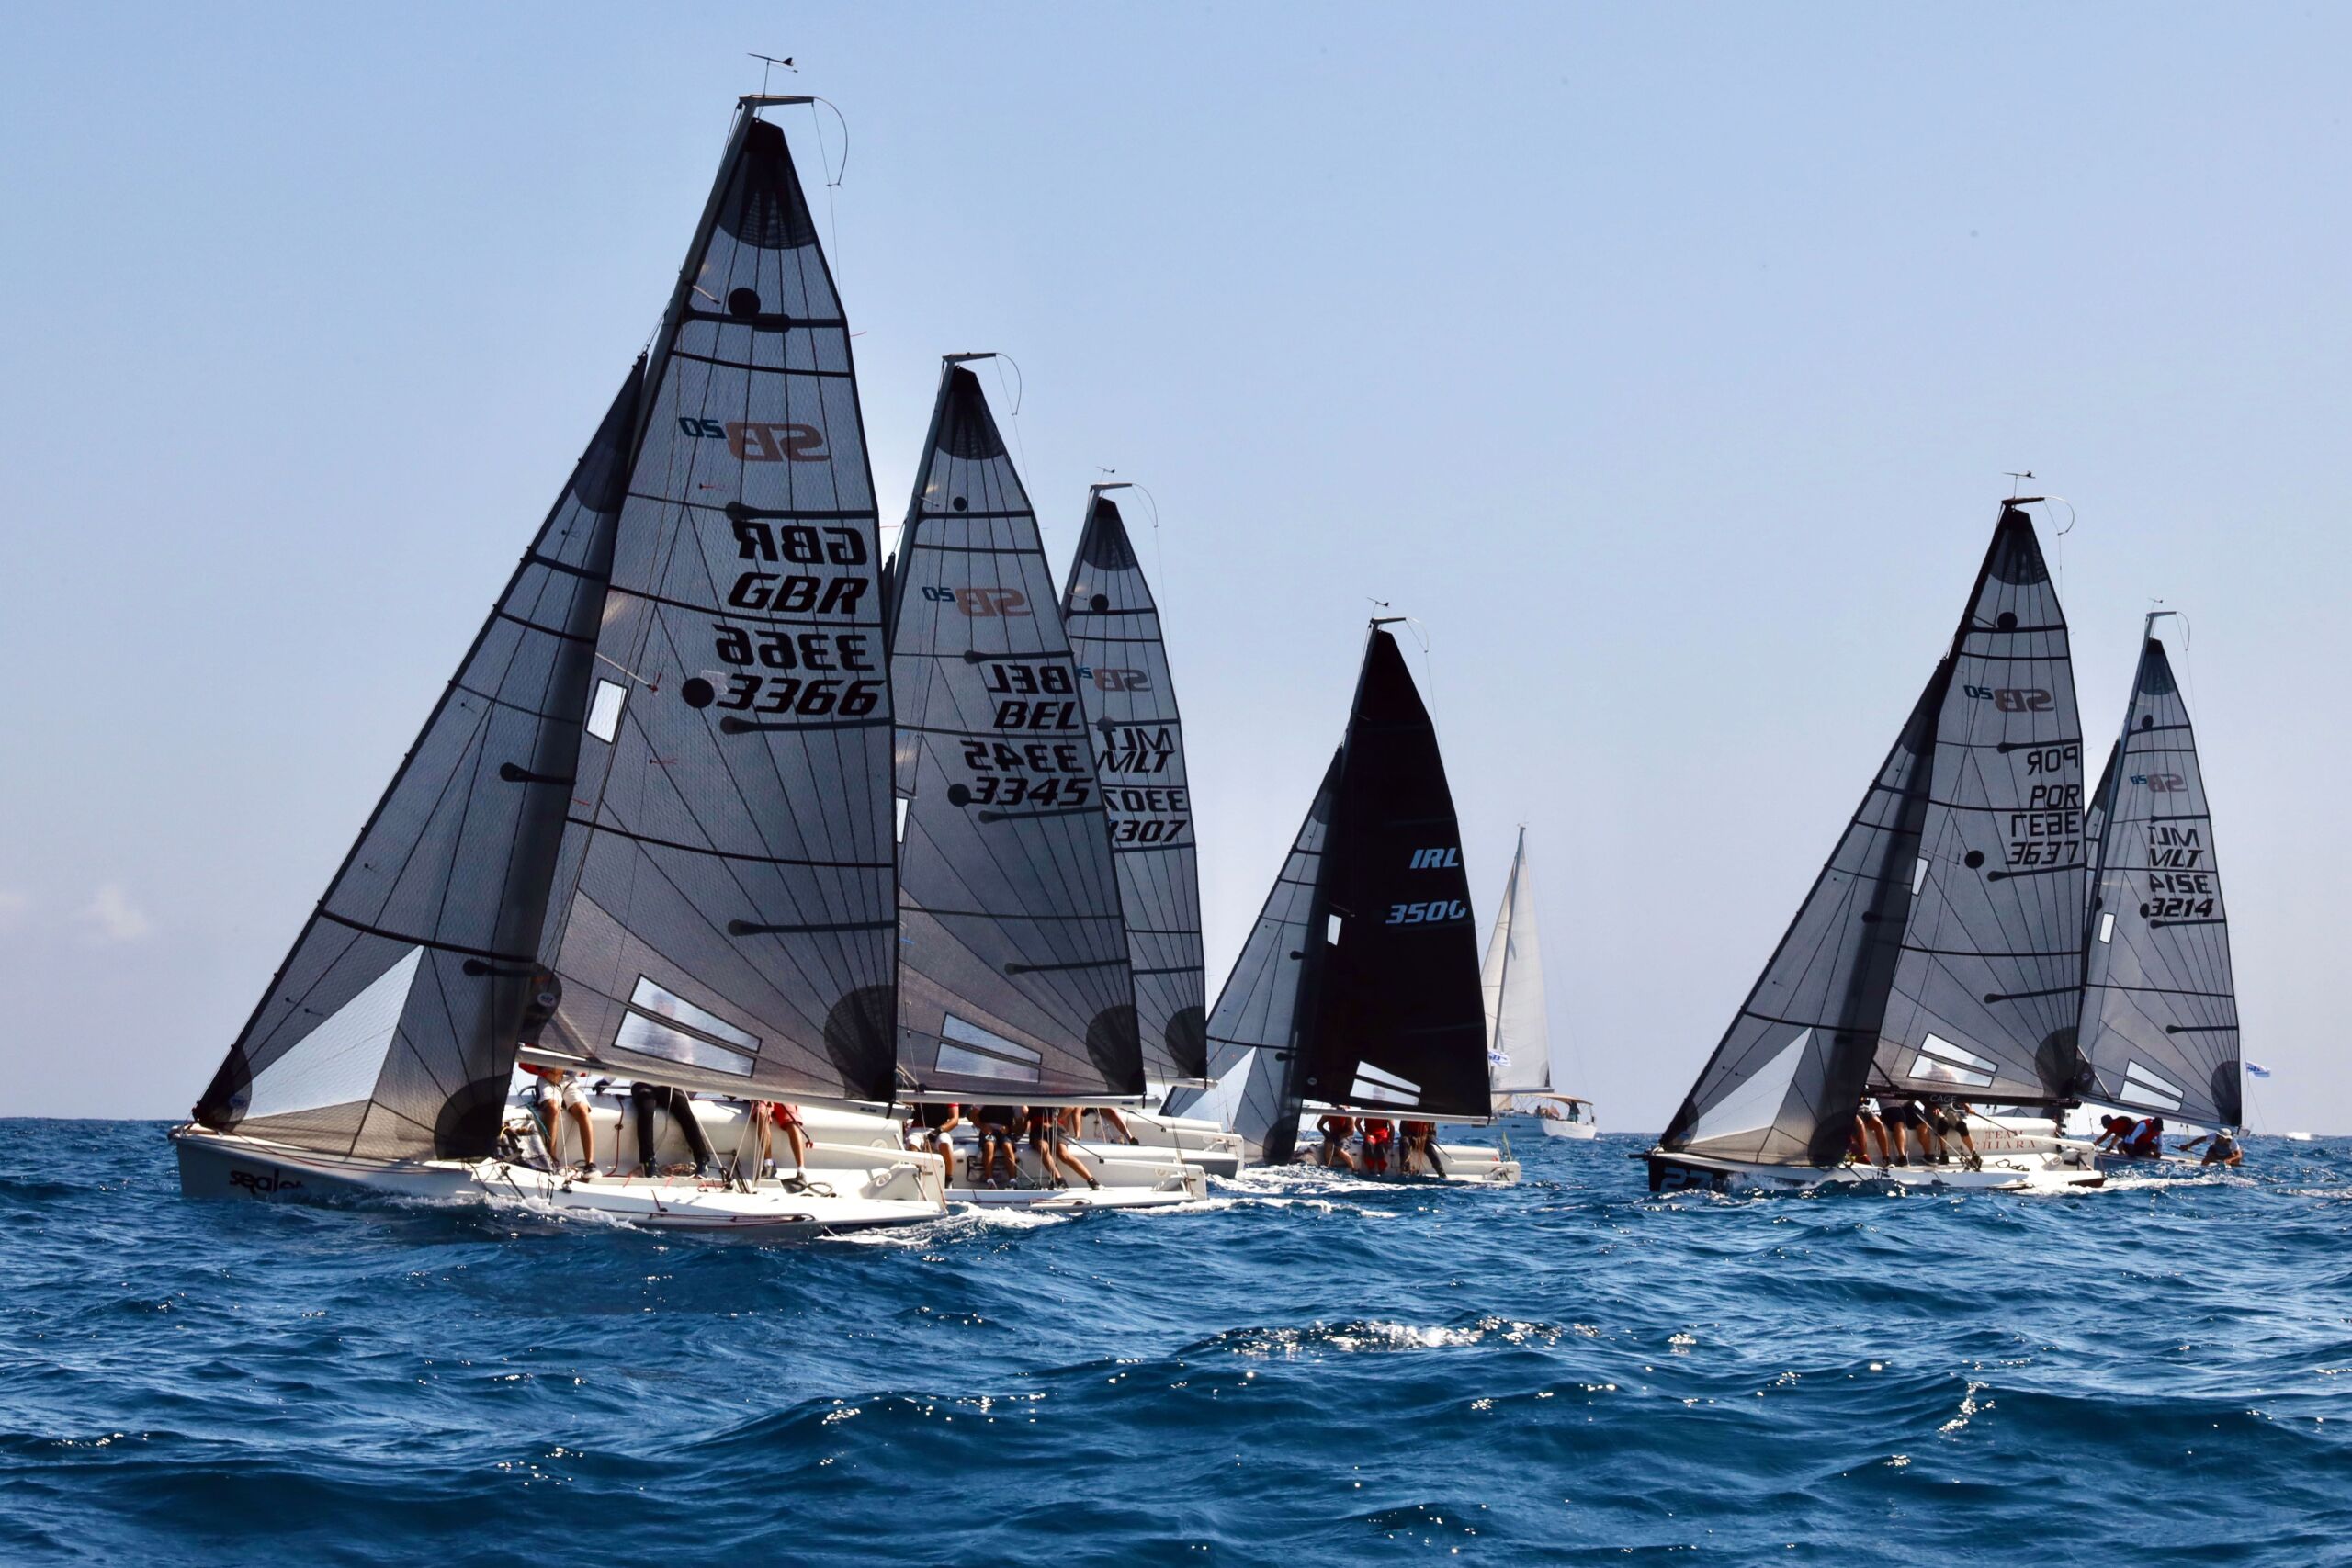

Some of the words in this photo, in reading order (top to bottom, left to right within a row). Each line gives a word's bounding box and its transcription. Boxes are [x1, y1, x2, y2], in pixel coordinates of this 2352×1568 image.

[729, 571, 868, 614] GBR
[717, 673, 886, 716] 3366
[993, 701, 1080, 729] BEL
[1097, 750, 1175, 773] MLT
[969, 777, 1094, 806] 3345
[2030, 784, 2080, 809] POR
[1409, 848, 1459, 869] IRL
[2005, 840, 2079, 865] 3637
[2148, 848, 2204, 868] MLT
[2149, 898, 2214, 917] 3214
[1975, 1140, 2035, 1151] HIARA
